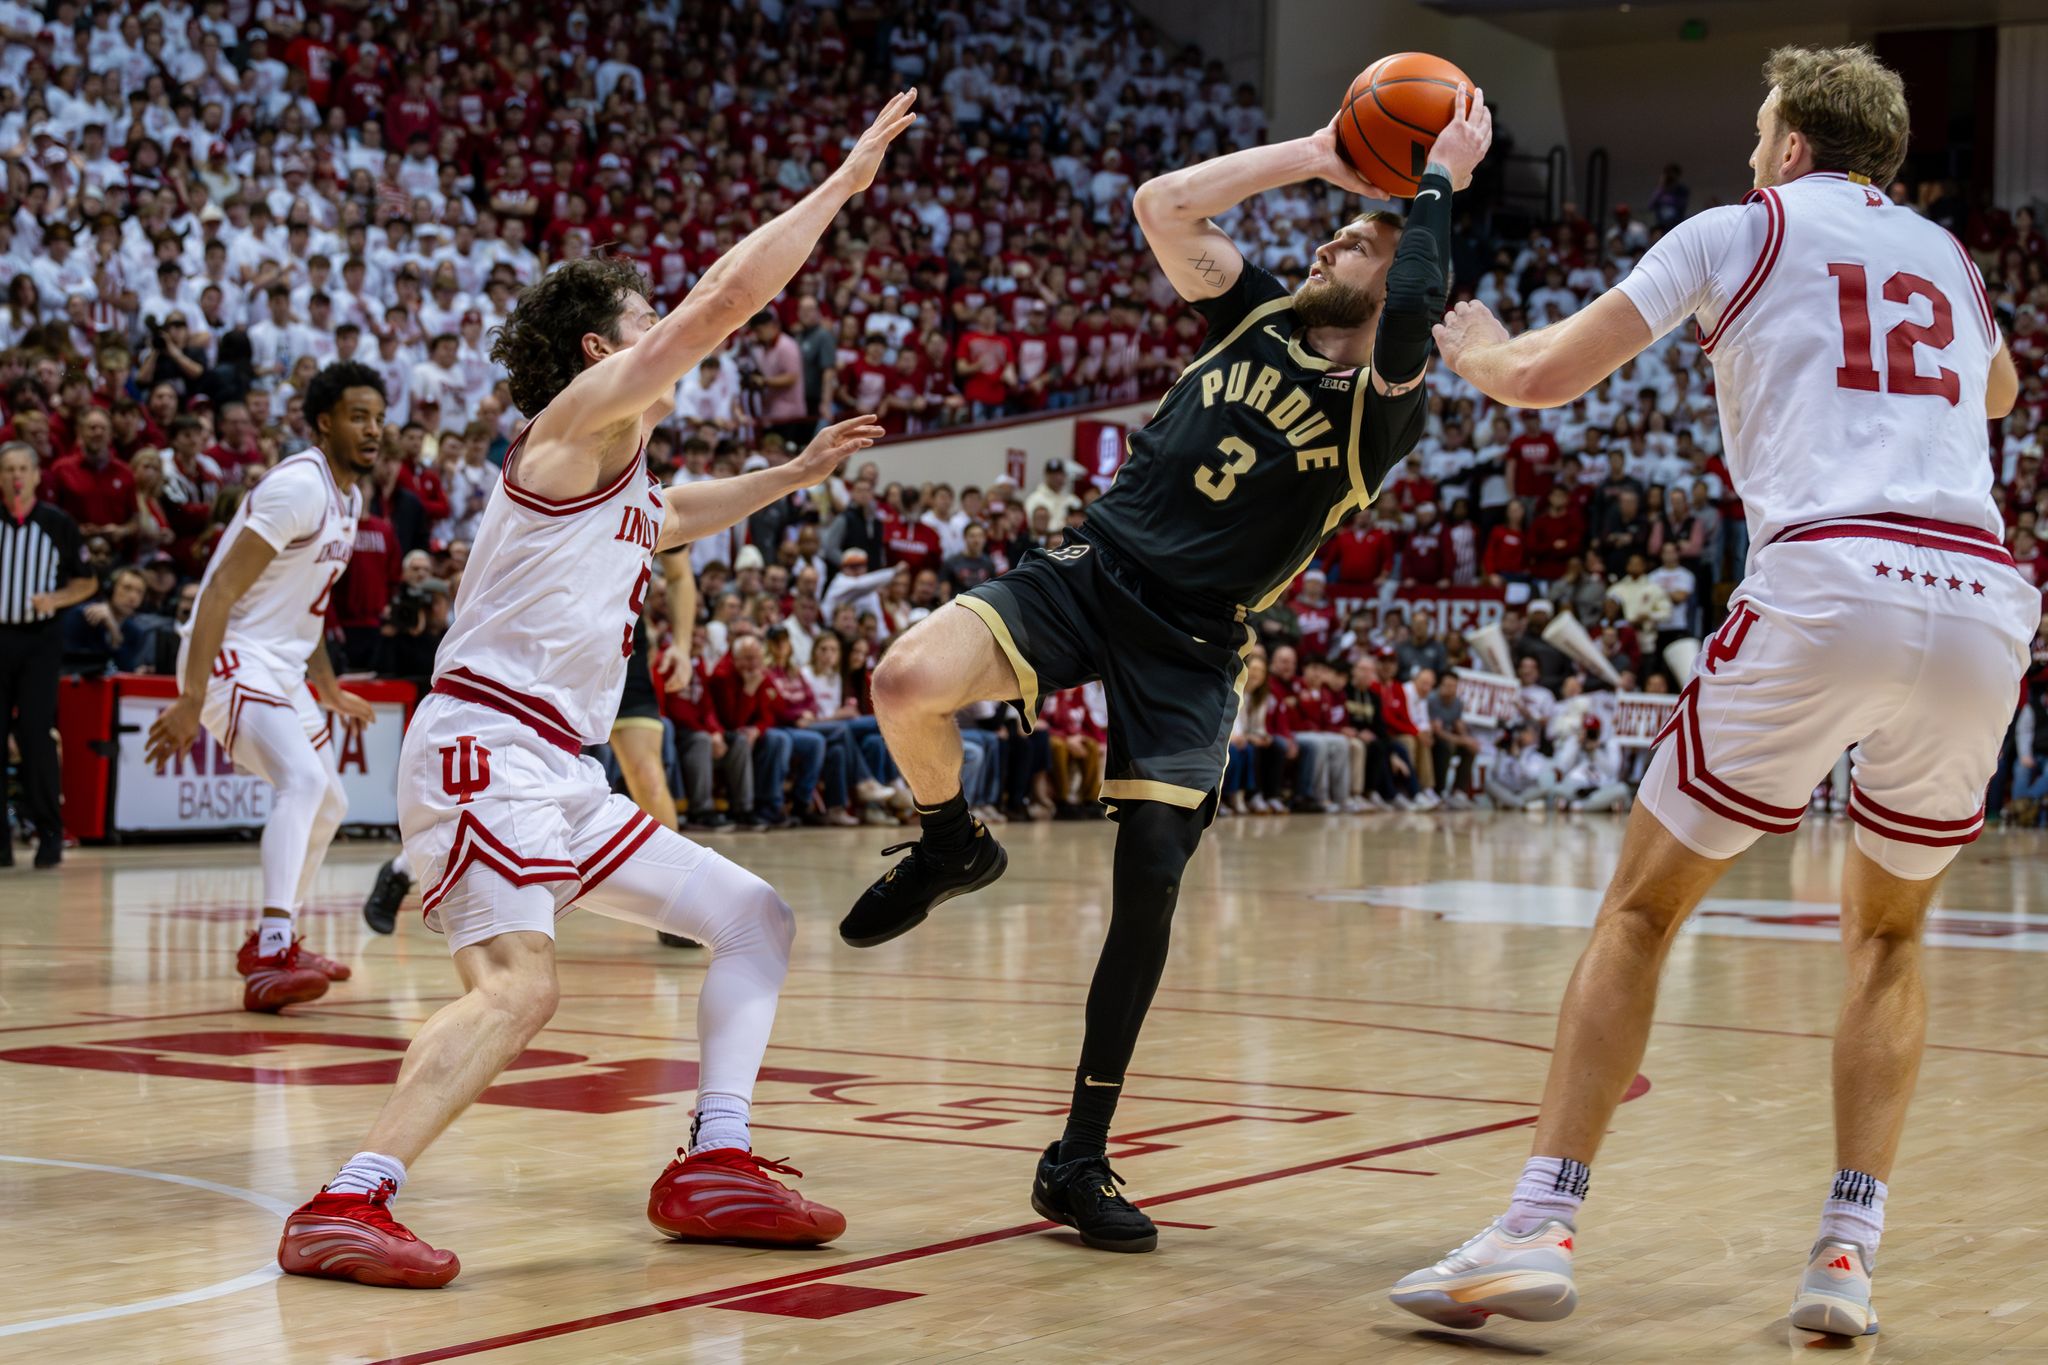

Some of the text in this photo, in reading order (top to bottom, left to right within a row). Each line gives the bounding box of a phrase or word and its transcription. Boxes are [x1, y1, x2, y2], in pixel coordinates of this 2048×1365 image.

[1827, 263, 1960, 407] 12
[1202, 361, 1339, 472] PURDUE
[1194, 436, 1257, 501] 3
[178, 780, 266, 820] BASKE
